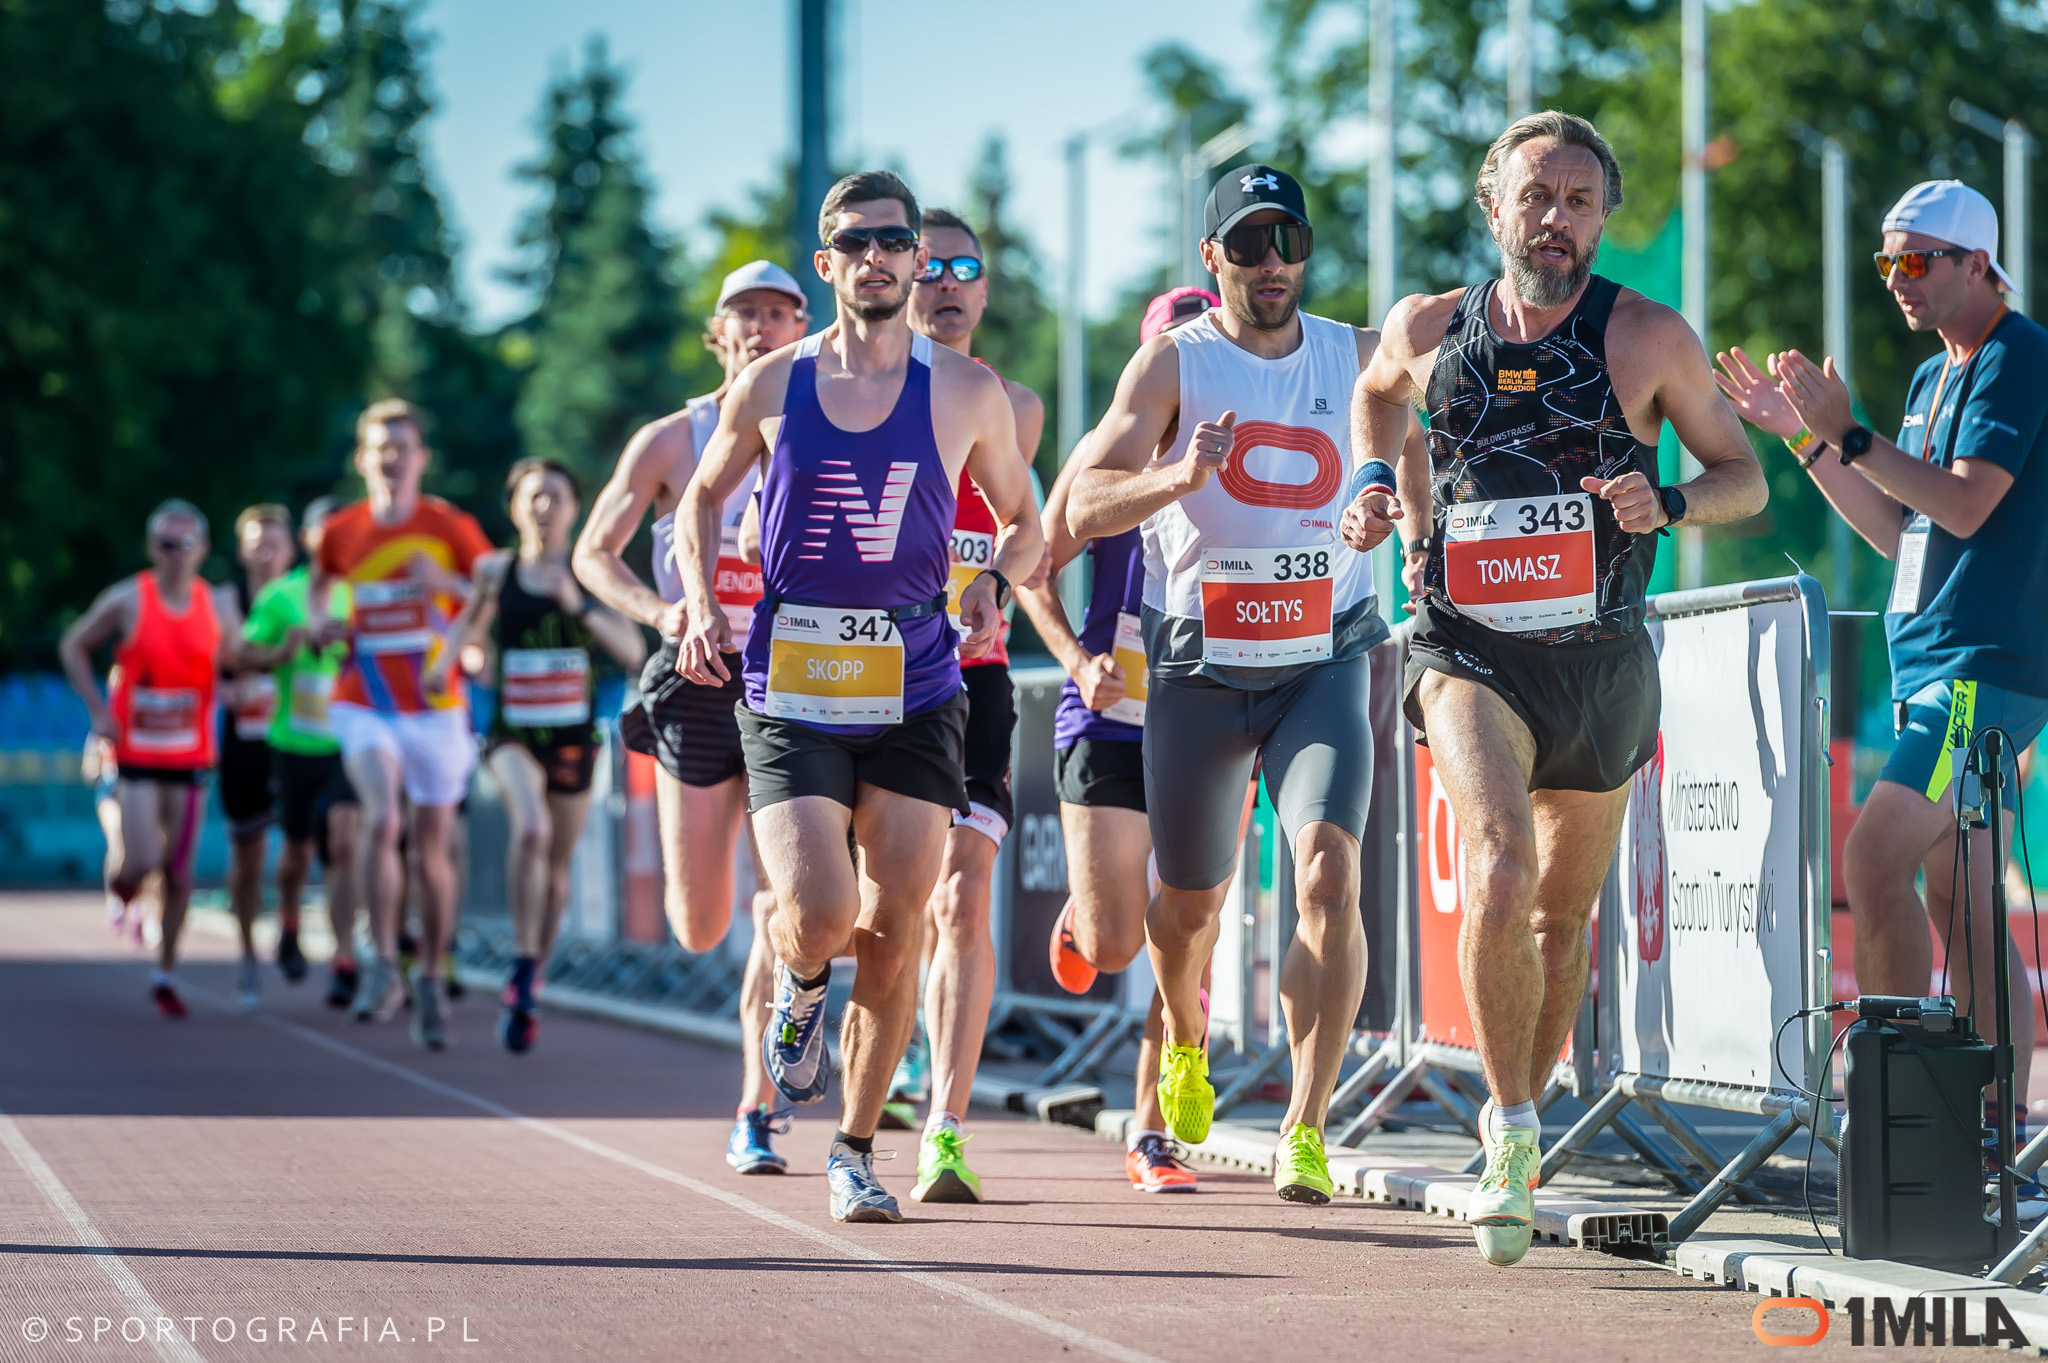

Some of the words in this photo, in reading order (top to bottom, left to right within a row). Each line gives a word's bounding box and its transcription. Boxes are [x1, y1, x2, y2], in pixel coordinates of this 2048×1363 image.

[1498, 369, 1523, 379] BMW
[1497, 384, 1537, 392] MARATHON
[1518, 500, 1586, 535] 343
[1221, 560, 1254, 571] 1MILA
[1273, 550, 1330, 581] 338
[1476, 554, 1563, 585] TOMASZ
[789, 617, 820, 629] 1MILA
[1235, 598, 1303, 624] SOŁTYS
[838, 615, 893, 642] 347
[805, 657, 865, 682] SKOPP
[1667, 770, 1740, 832] Ministerstwo
[1672, 869, 1708, 946] Sportu
[1714, 866, 1774, 950] Turystyki
